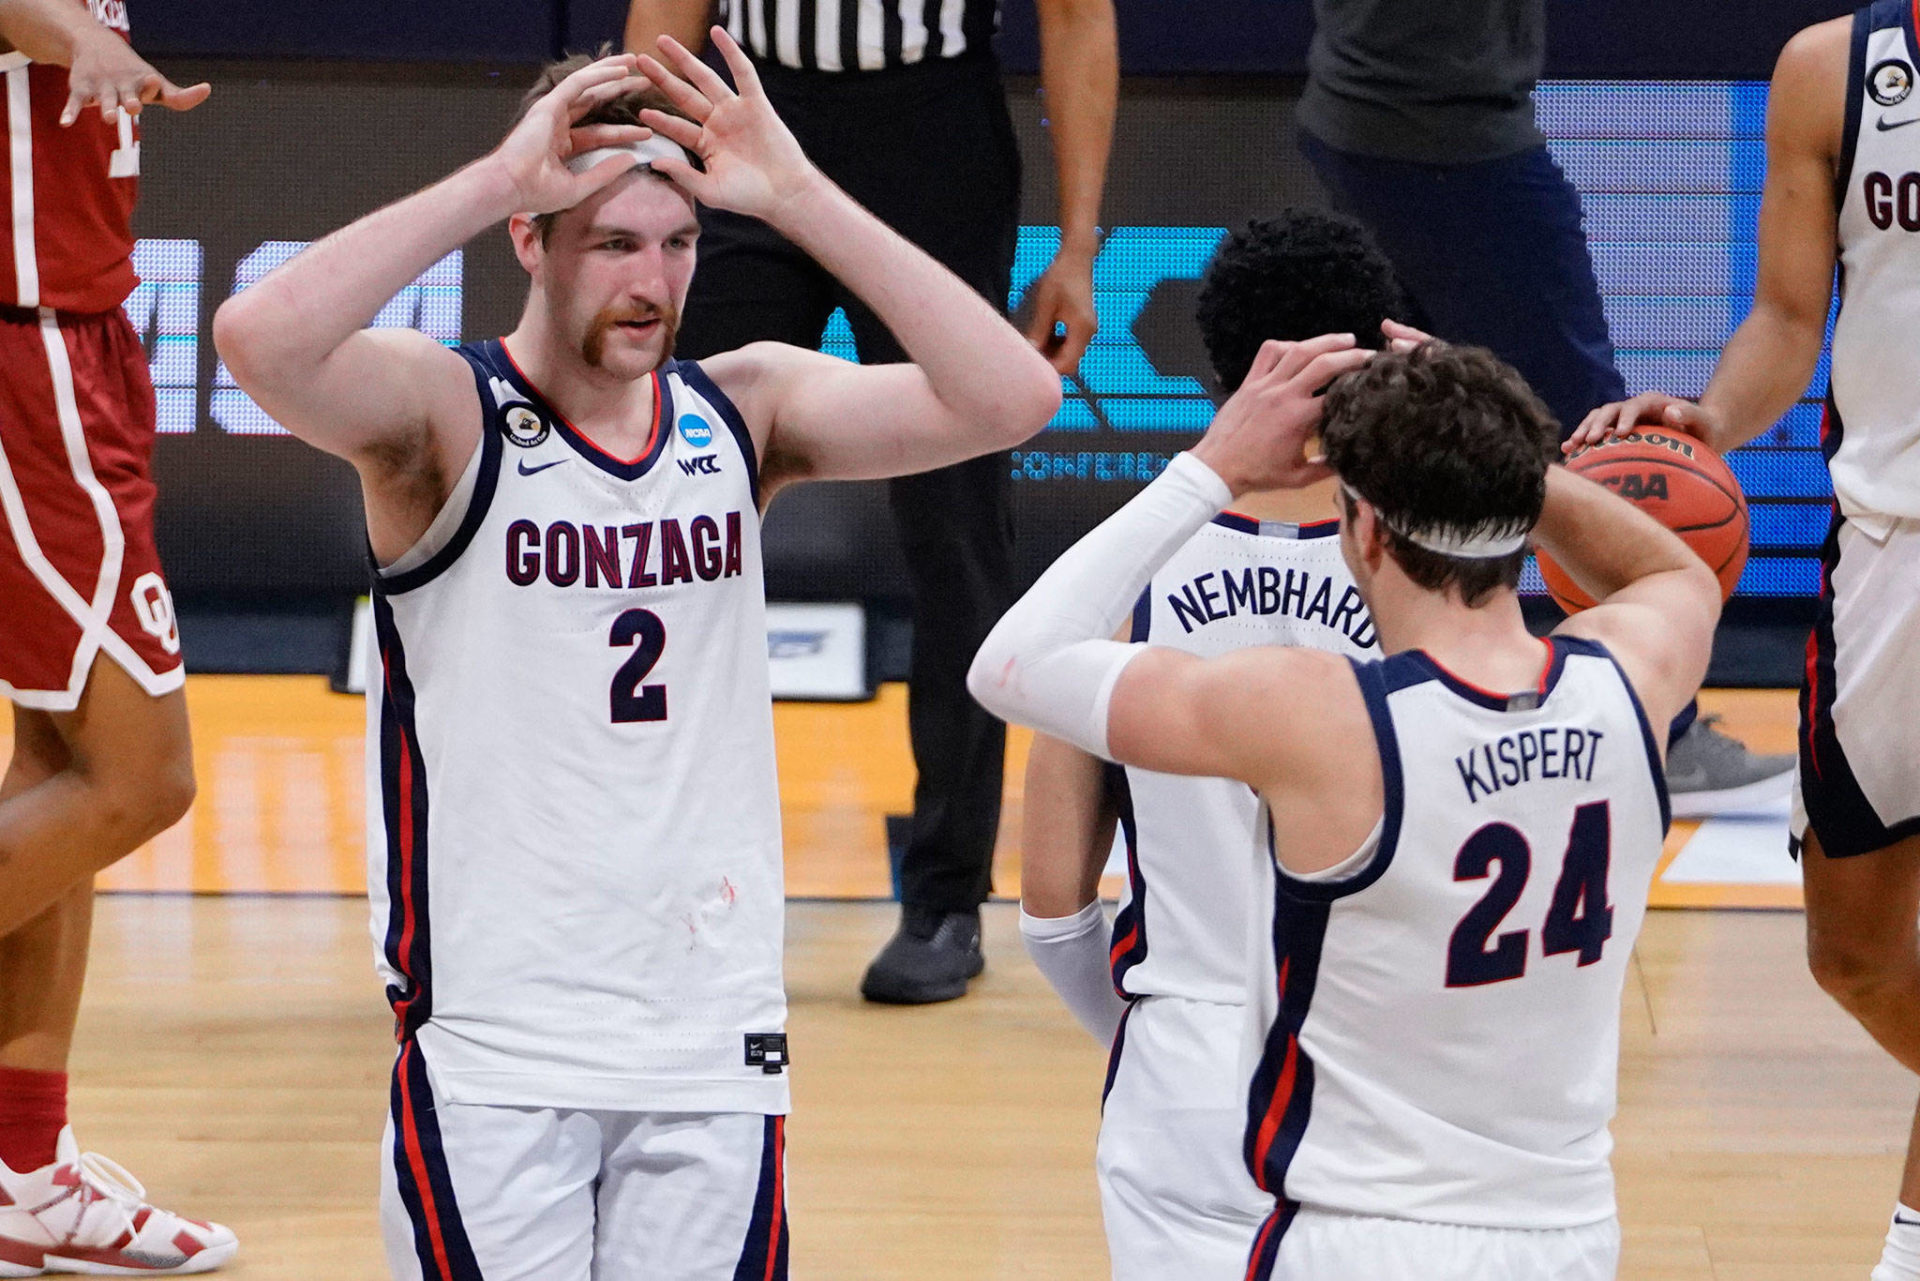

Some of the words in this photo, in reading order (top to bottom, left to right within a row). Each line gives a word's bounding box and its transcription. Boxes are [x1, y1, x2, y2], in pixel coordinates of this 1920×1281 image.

[1863, 171, 1920, 232] GO
[677, 454, 722, 476] WCC
[685, 428, 711, 438] NCAA
[506, 511, 742, 589] GONZAGA
[609, 608, 668, 723] 2
[1455, 728, 1604, 803] KISPERT
[1445, 799, 1615, 988] 24
